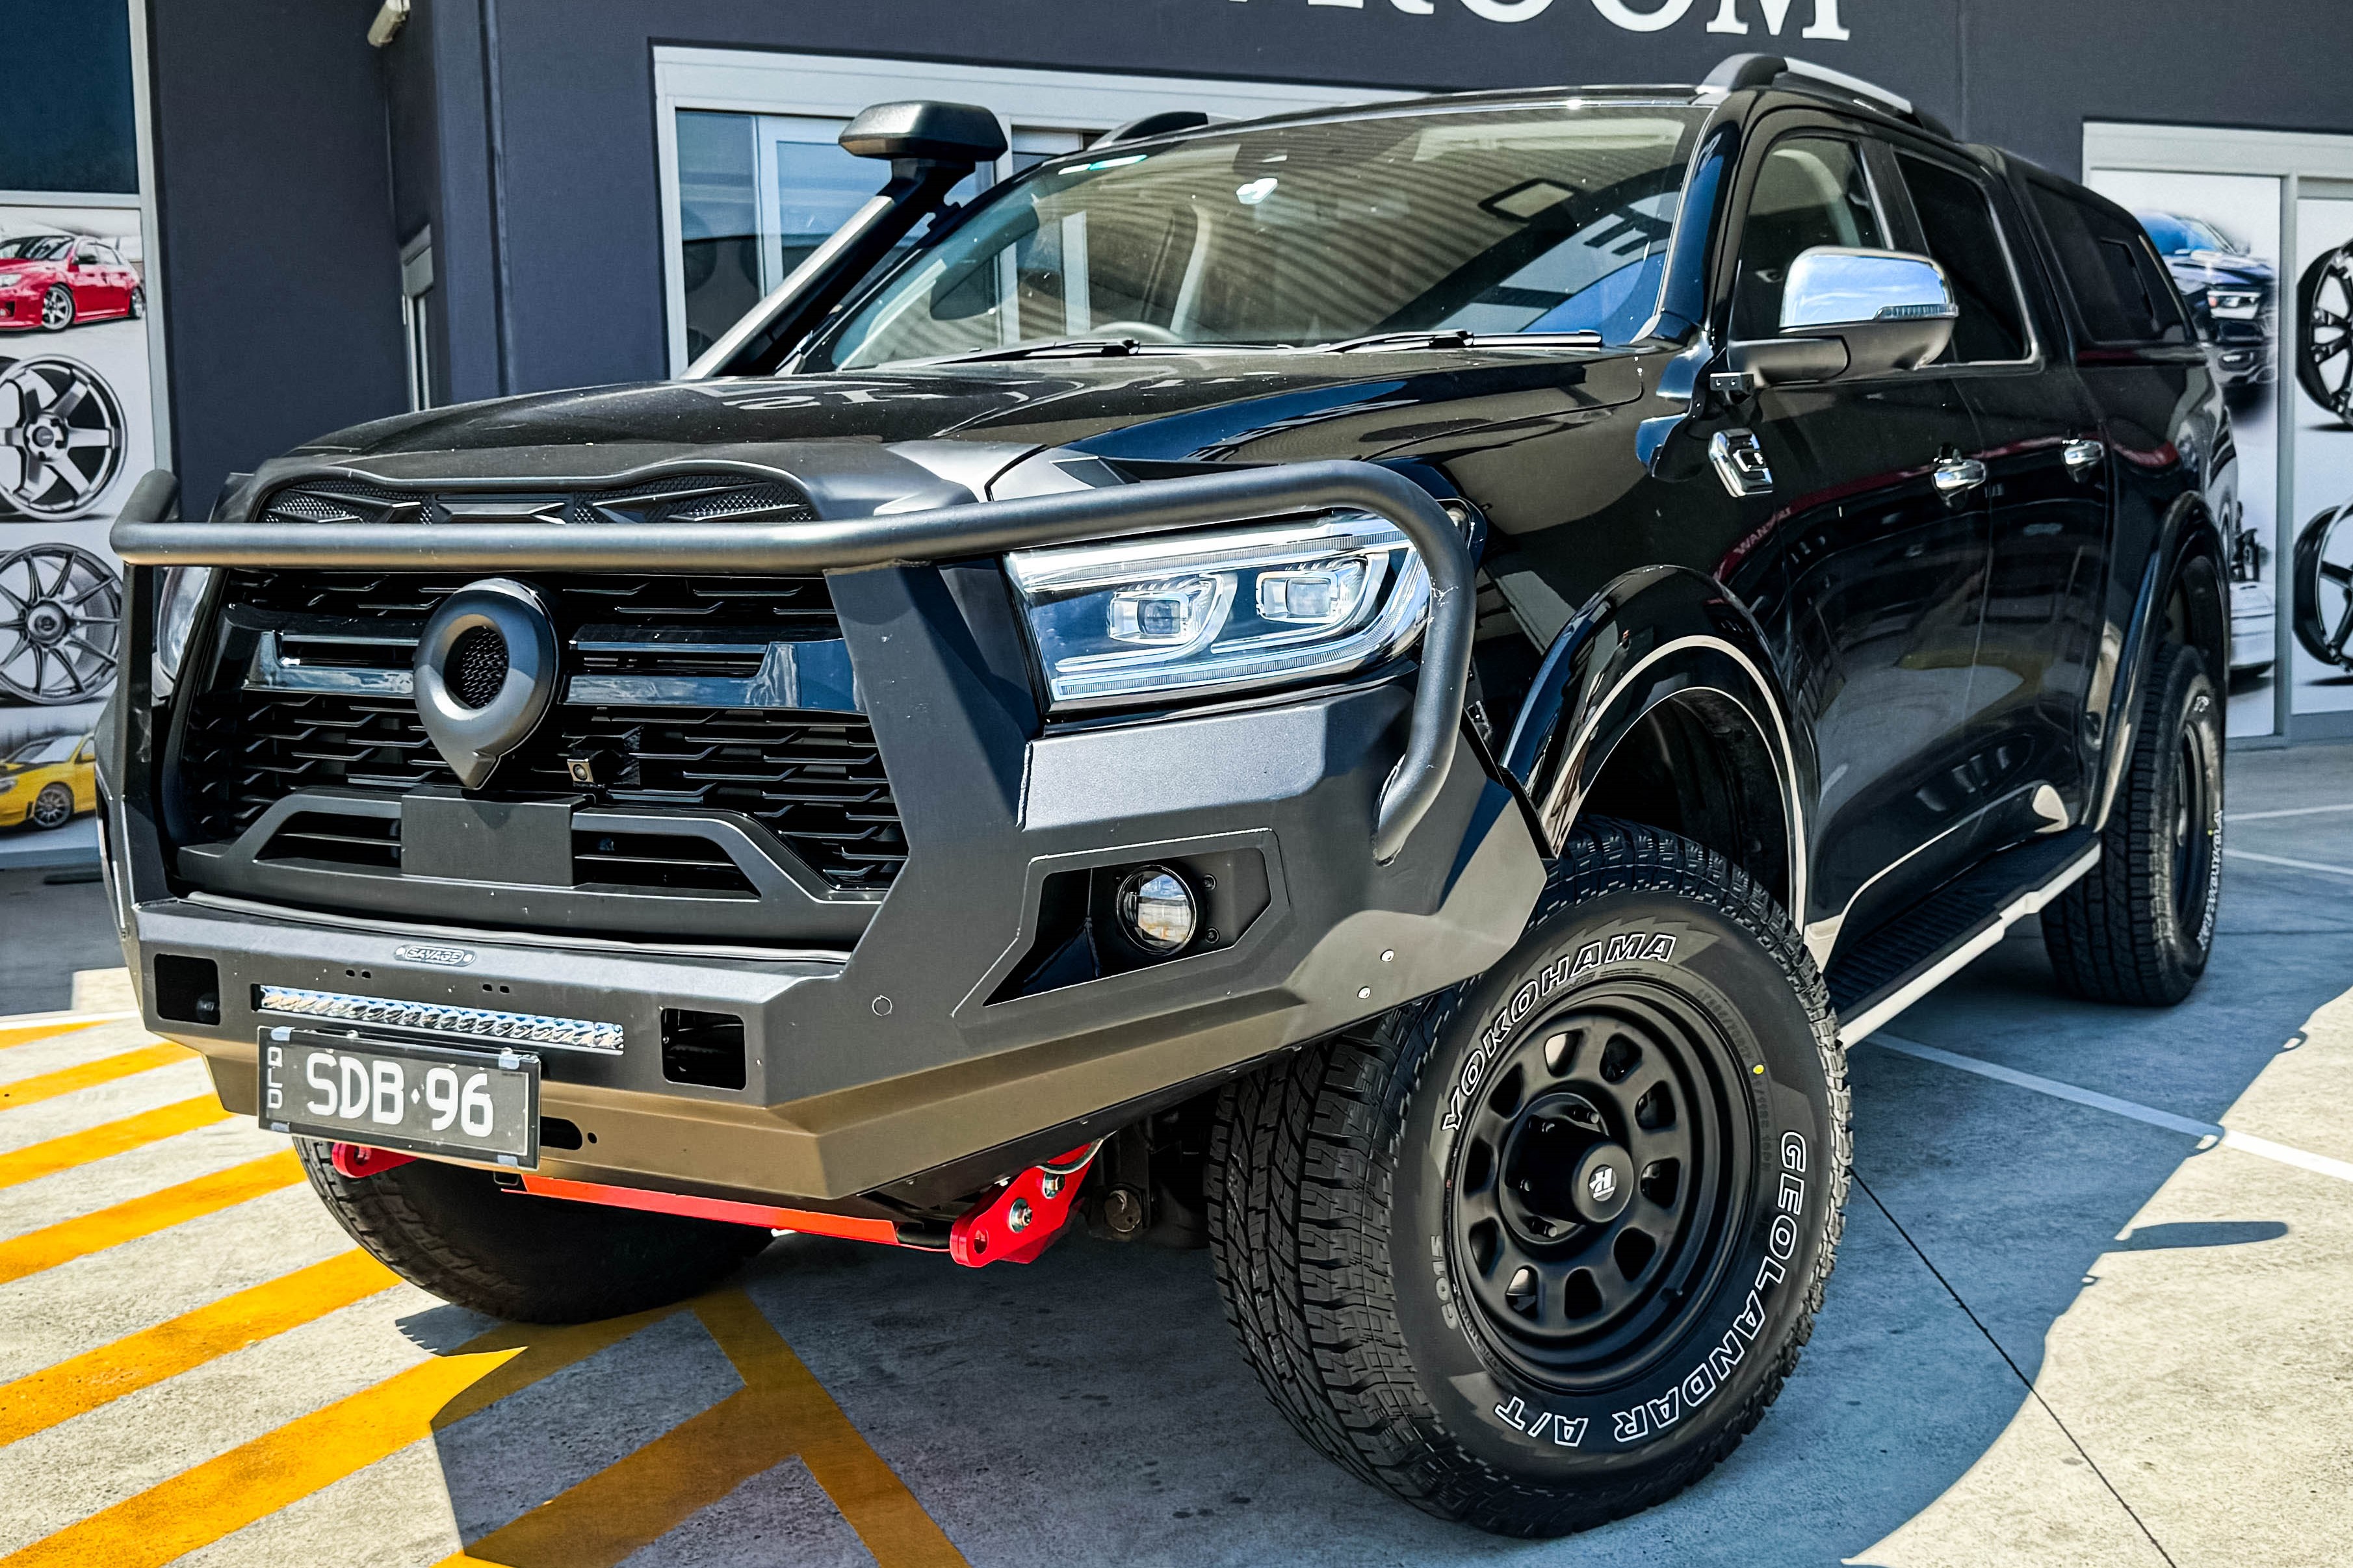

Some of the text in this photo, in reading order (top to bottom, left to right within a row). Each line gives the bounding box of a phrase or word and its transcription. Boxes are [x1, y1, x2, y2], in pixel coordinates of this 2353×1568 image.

[407, 948, 462, 962] SAVAGE
[266, 1047, 284, 1109] QLD
[1442, 933, 1676, 1130] YOKOHAMA
[1495, 1131, 1807, 1447] GEOLANDAR A/T
